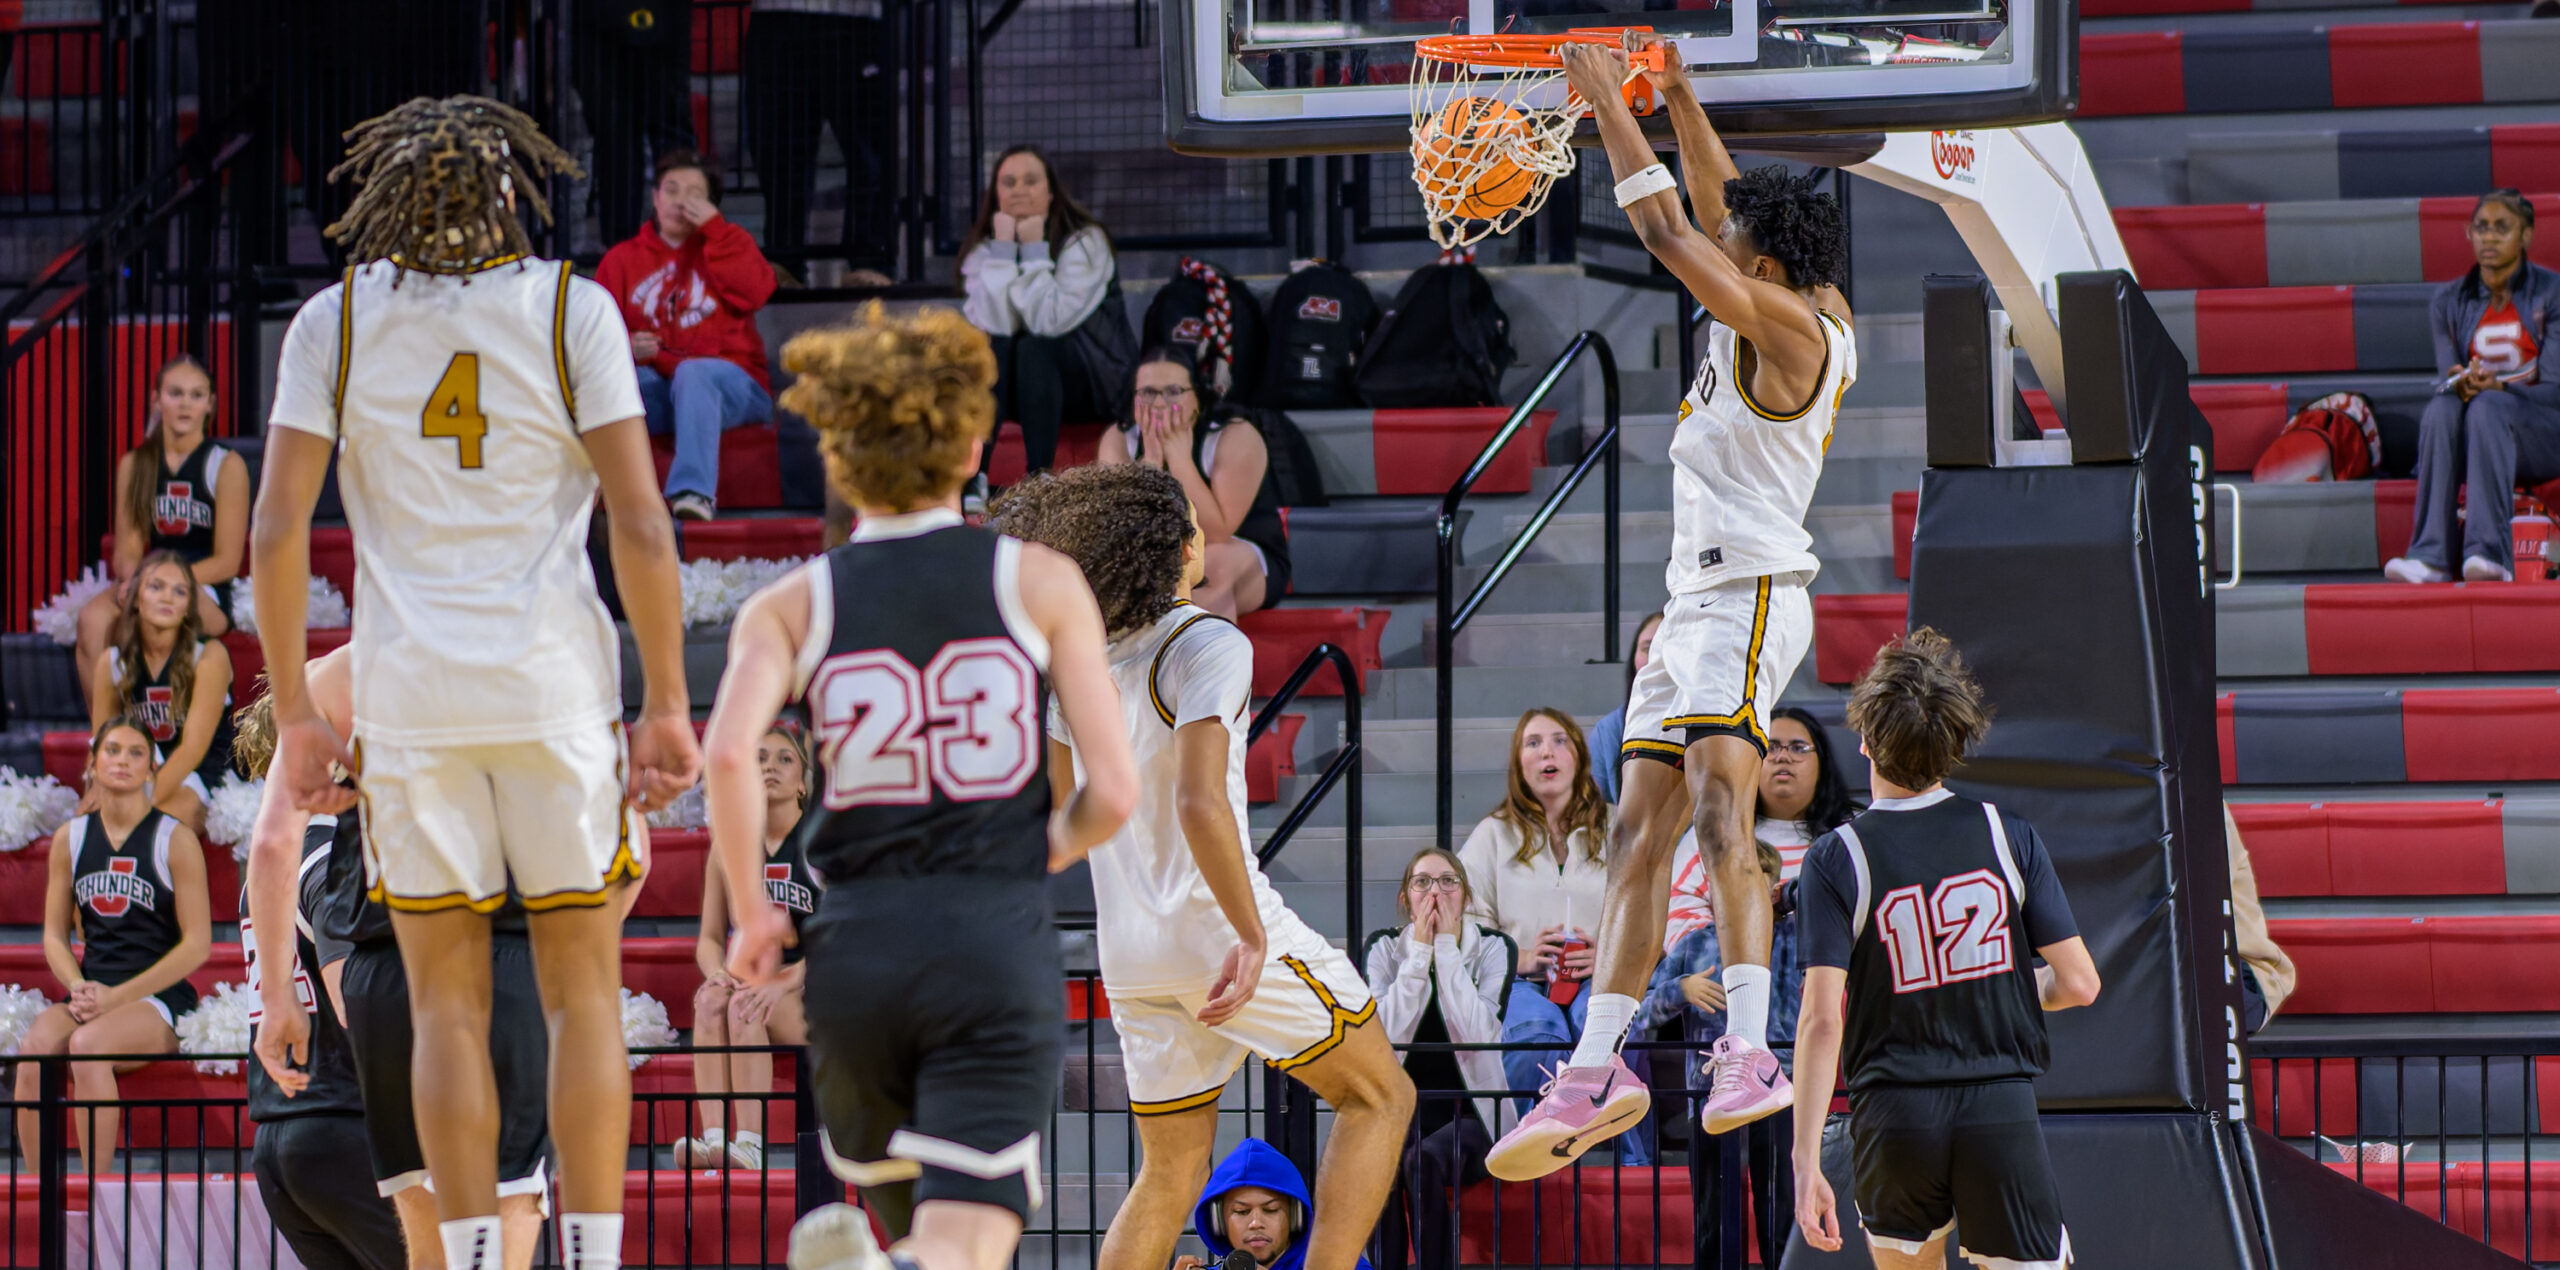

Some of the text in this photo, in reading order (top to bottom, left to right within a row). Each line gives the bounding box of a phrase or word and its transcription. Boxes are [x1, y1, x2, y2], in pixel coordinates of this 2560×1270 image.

[2474, 322, 2522, 372] S
[421, 351, 488, 470] 4
[807, 635, 1041, 812] 23
[75, 870, 155, 912] THUNDER
[763, 878, 814, 914] NDER
[1874, 868, 2014, 994] 12
